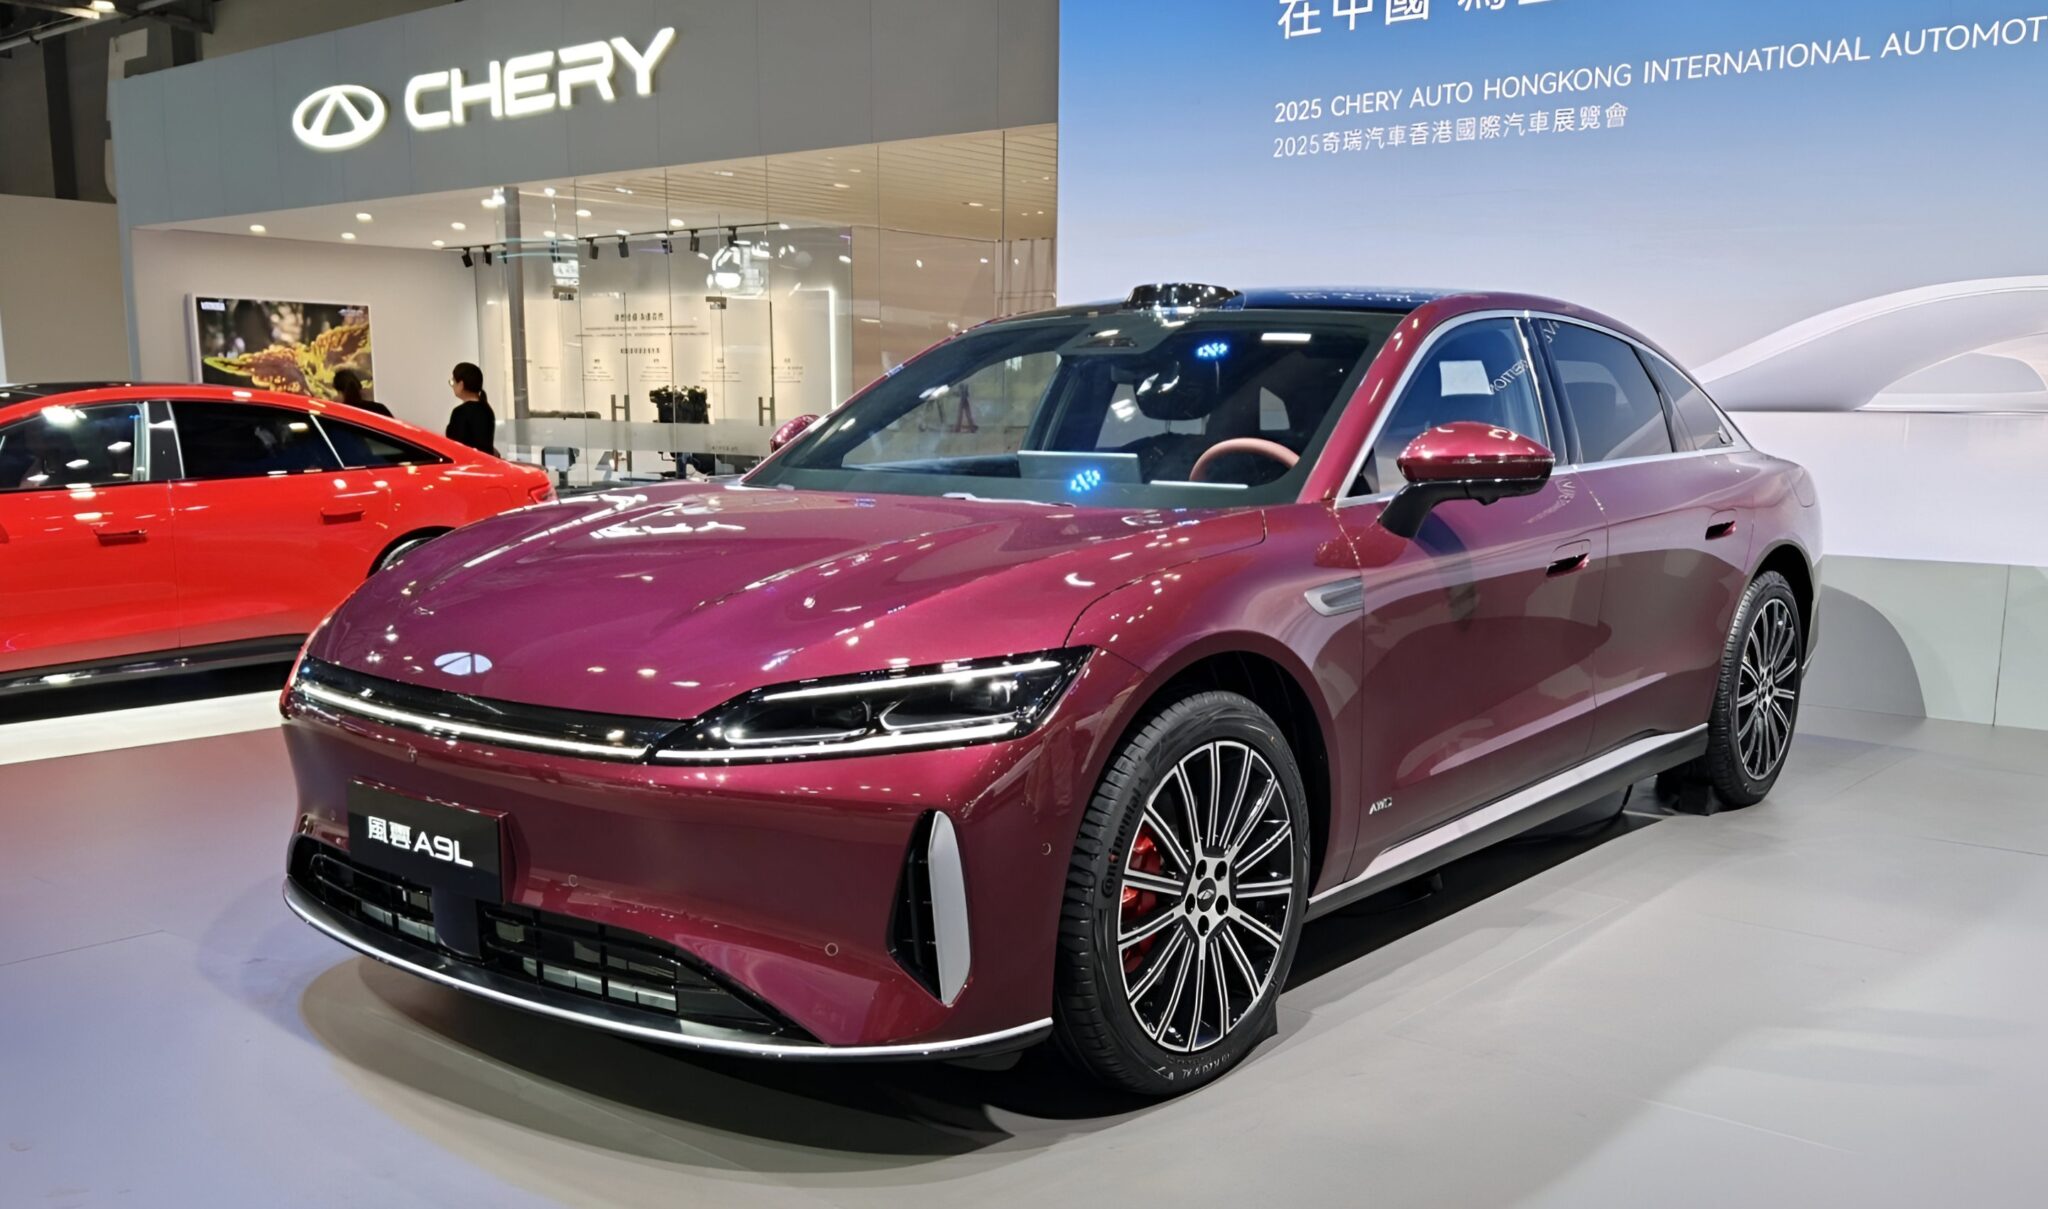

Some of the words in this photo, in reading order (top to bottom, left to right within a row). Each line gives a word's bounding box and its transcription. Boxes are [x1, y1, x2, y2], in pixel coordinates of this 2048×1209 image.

[404, 26, 677, 131] CHERY
[1274, 98, 1322, 123] 2025
[1330, 88, 1403, 117] CHERY
[1409, 81, 1474, 109] AUTO
[1483, 63, 1633, 101] HONGKONG
[1642, 36, 1871, 84] INTERNATIONAL
[1880, 15, 2048, 59] AUTOMOT
[1101, 787, 1142, 899] Coninental
